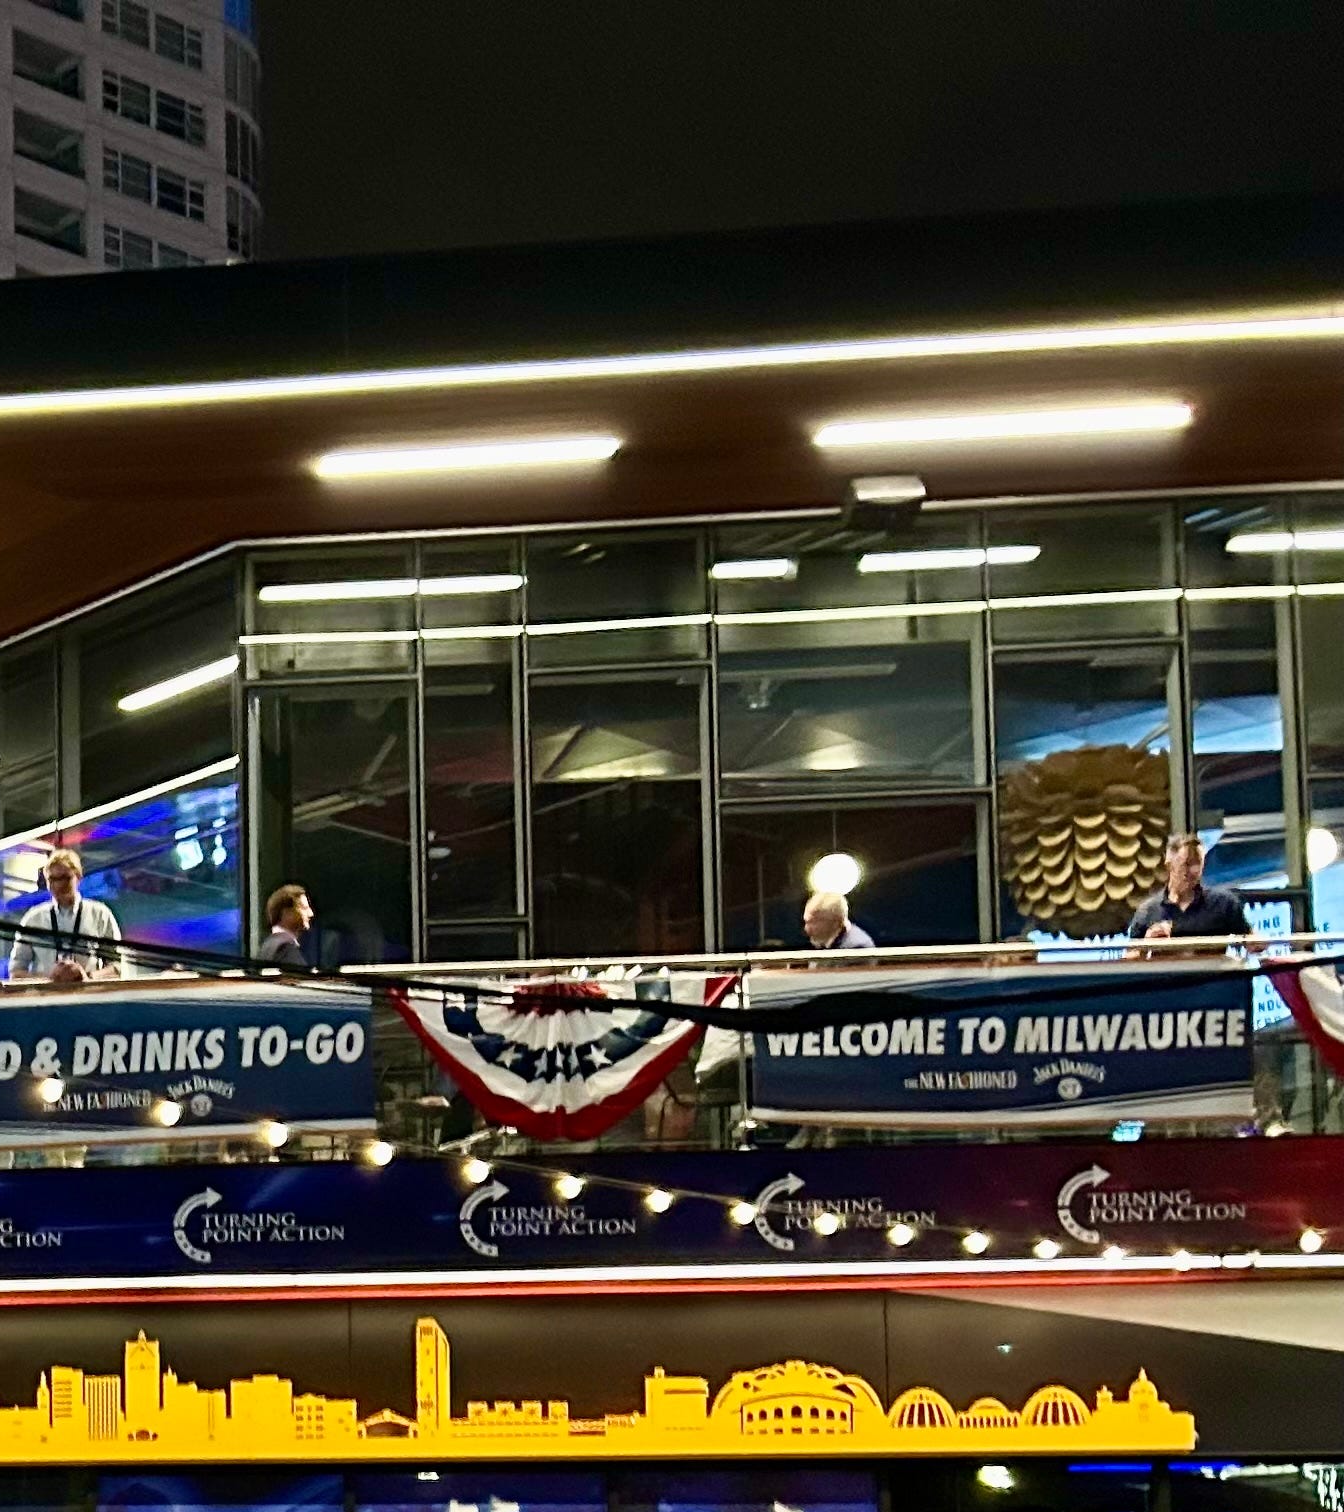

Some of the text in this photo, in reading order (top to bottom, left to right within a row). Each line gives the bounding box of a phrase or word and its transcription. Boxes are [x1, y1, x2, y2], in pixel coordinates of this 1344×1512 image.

[767, 1009, 1247, 1058] WELCOME TO MILWAUKEE
[31, 1036, 63, 1077] &
[72, 1029, 226, 1076] DRINKS
[238, 1022, 366, 1068] TO-GO
[919, 1071, 947, 1090] NEW
[785, 1197, 884, 1214] TURNING
[1088, 1189, 1192, 1208] TURNING
[201, 1211, 297, 1229] TURNING
[487, 1205, 587, 1222] TURNING
[1089, 1203, 1247, 1224] POINT ACTION
[201, 1224, 346, 1244] POINT ACTION
[489, 1218, 638, 1236] POINT ACTION
